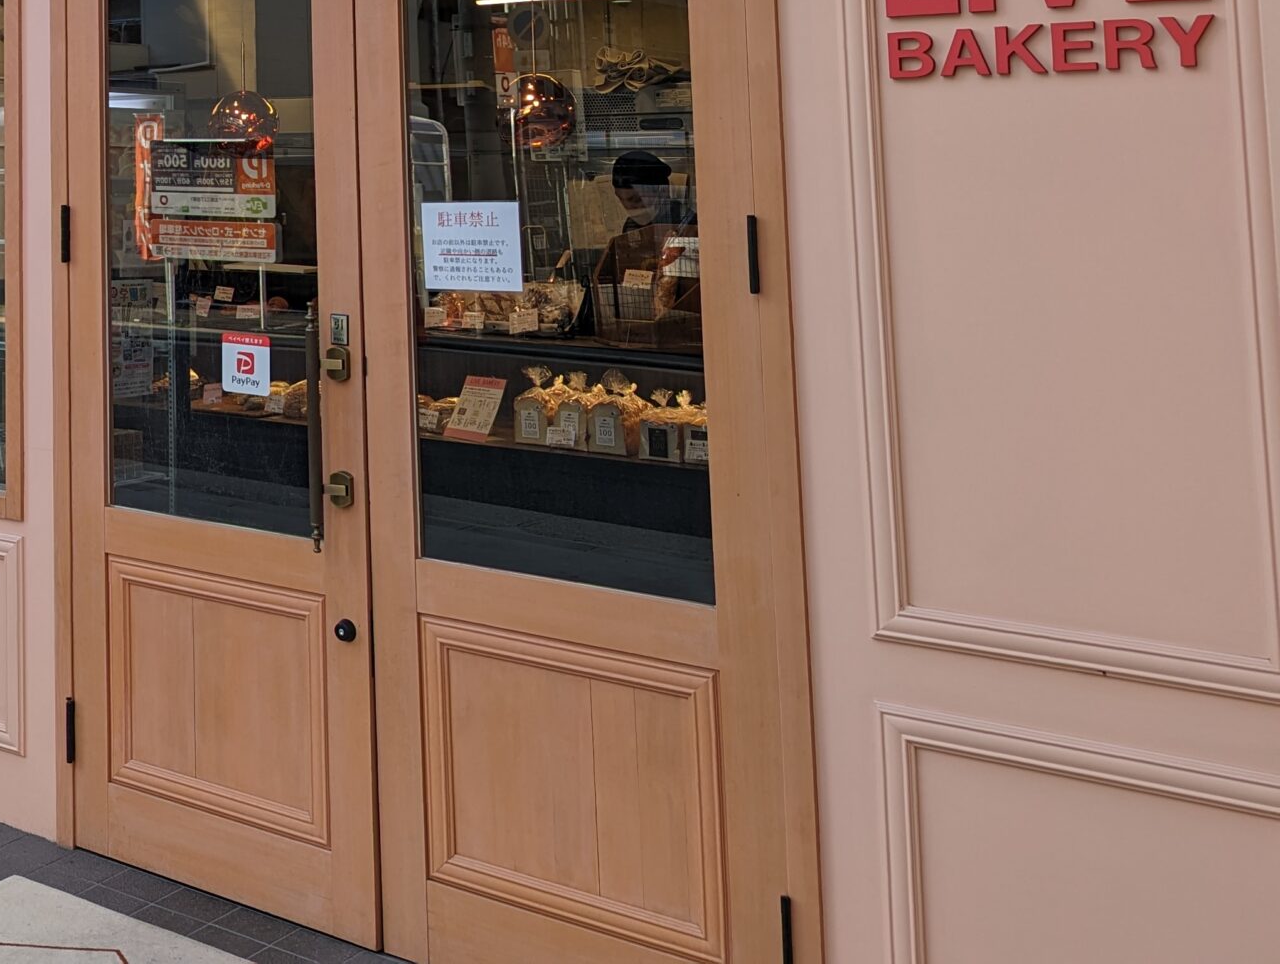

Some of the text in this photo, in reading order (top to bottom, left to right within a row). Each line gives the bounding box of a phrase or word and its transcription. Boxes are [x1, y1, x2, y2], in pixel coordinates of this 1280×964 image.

[886, 14, 1216, 80] BAKERY
[437, 211, 500, 228] 駐車禁止
[231, 375, 261, 388] PayPay
